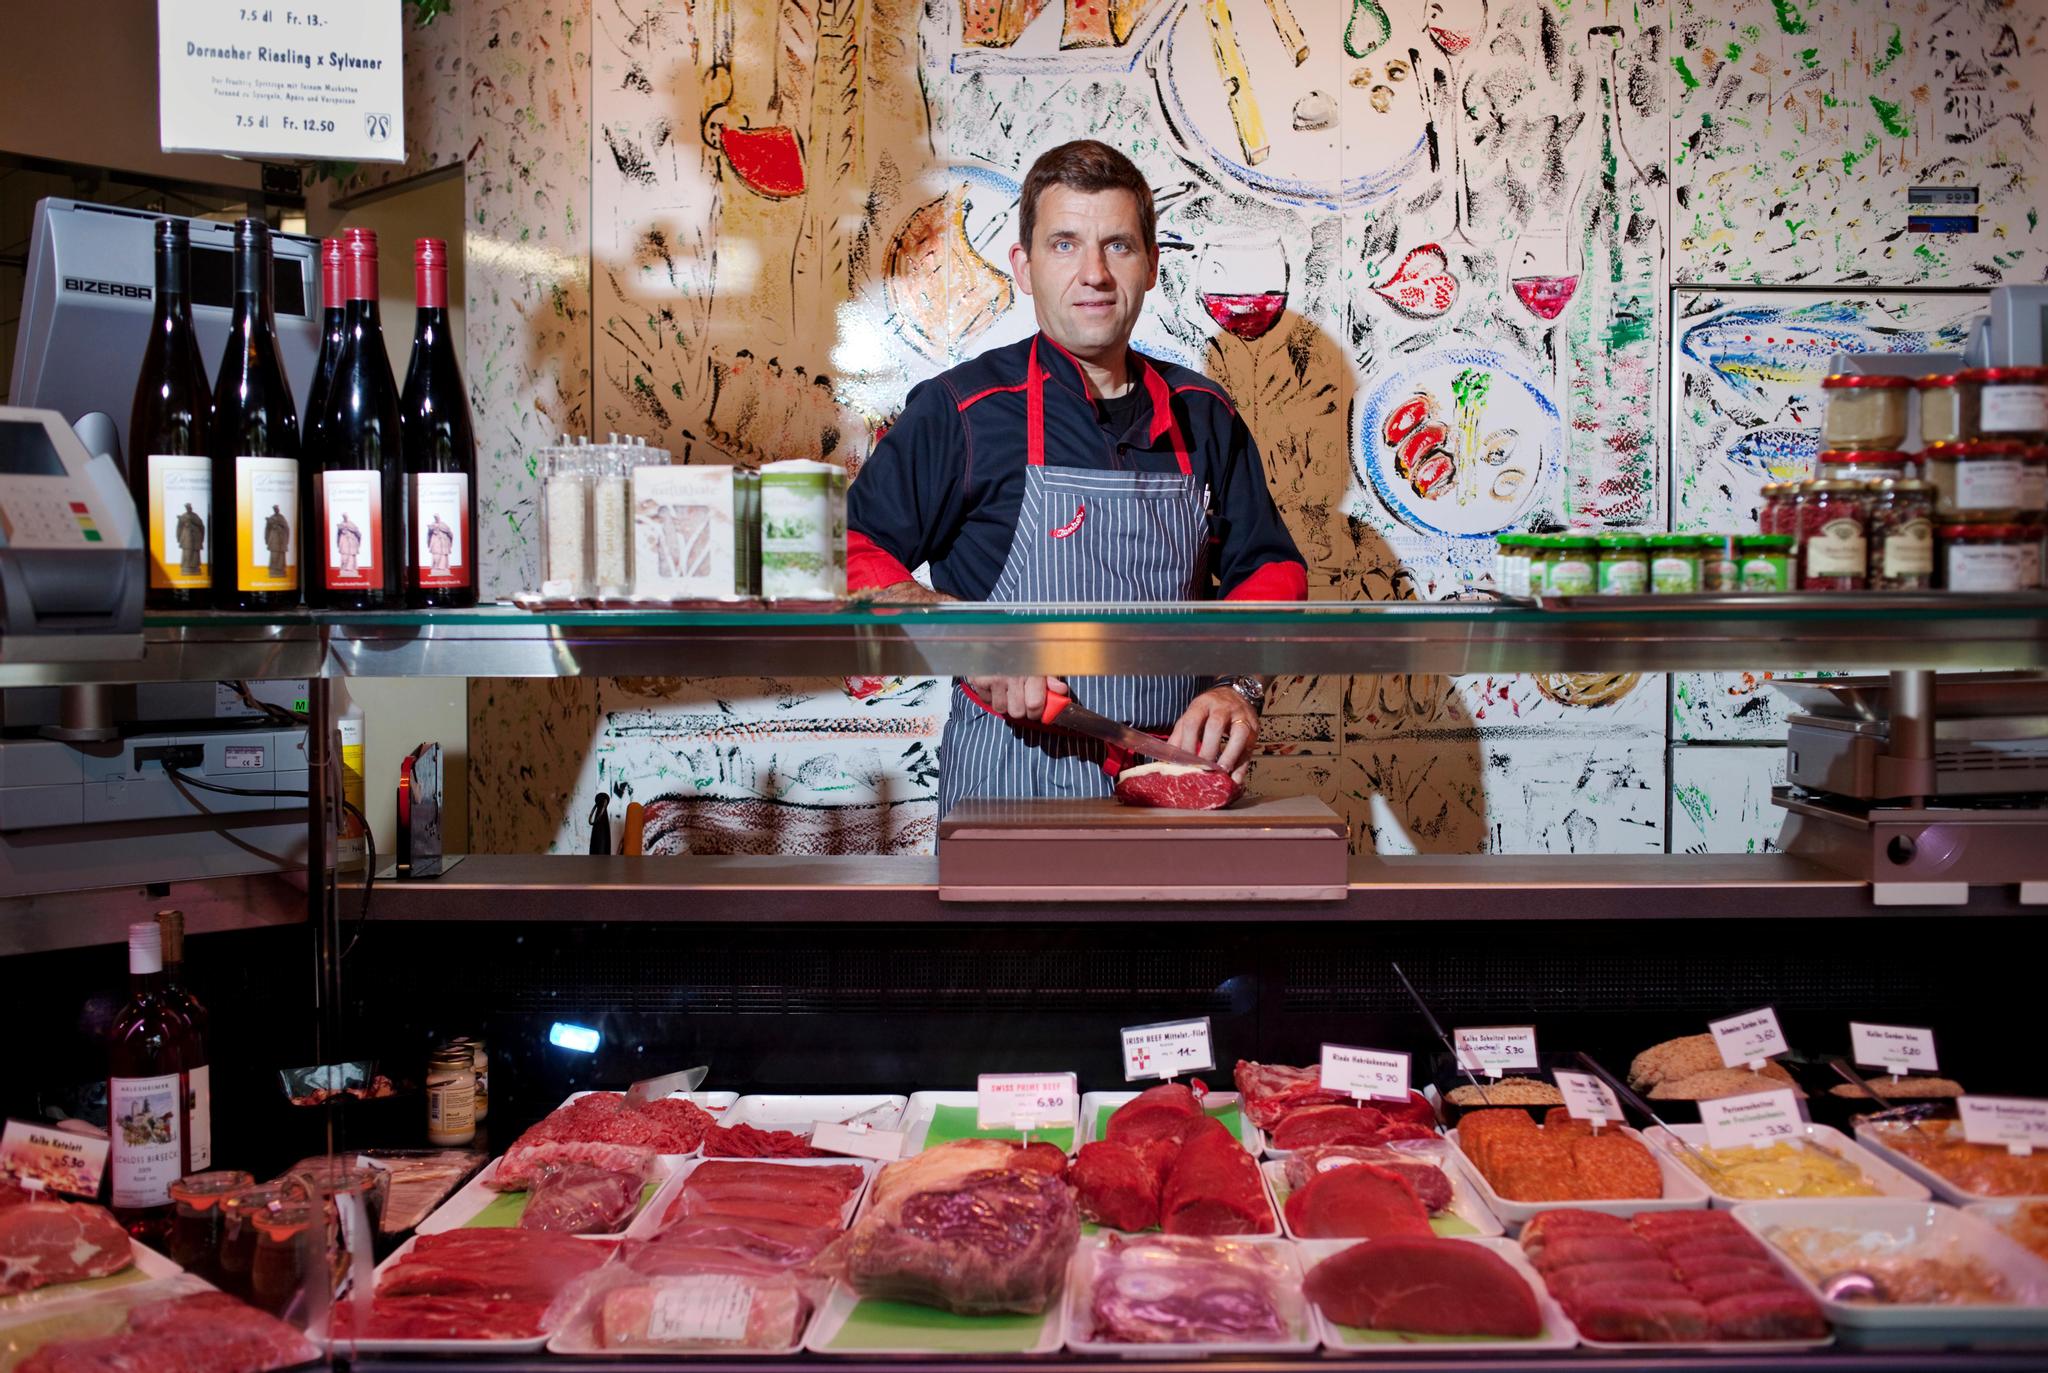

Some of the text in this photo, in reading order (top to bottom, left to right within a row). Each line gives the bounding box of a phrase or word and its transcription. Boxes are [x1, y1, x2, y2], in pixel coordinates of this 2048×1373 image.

[240, 9, 258, 22] 7.5
[263, 10, 273, 23] dl
[286, 12, 302, 26] Fr.
[186, 41, 383, 72] Dornacher Riesling x Sylvaner
[236, 115, 335, 133] 7.5 dl Fr. 12.50
[65, 278, 153, 300] BIZERBA
[295, 702, 305, 710] M
[1126, 1037, 1144, 1046] IRISH
[1146, 1034, 1163, 1044] BEEF
[991, 1083, 1014, 1093] SWISS
[1016, 1082, 1040, 1092] PRIME
